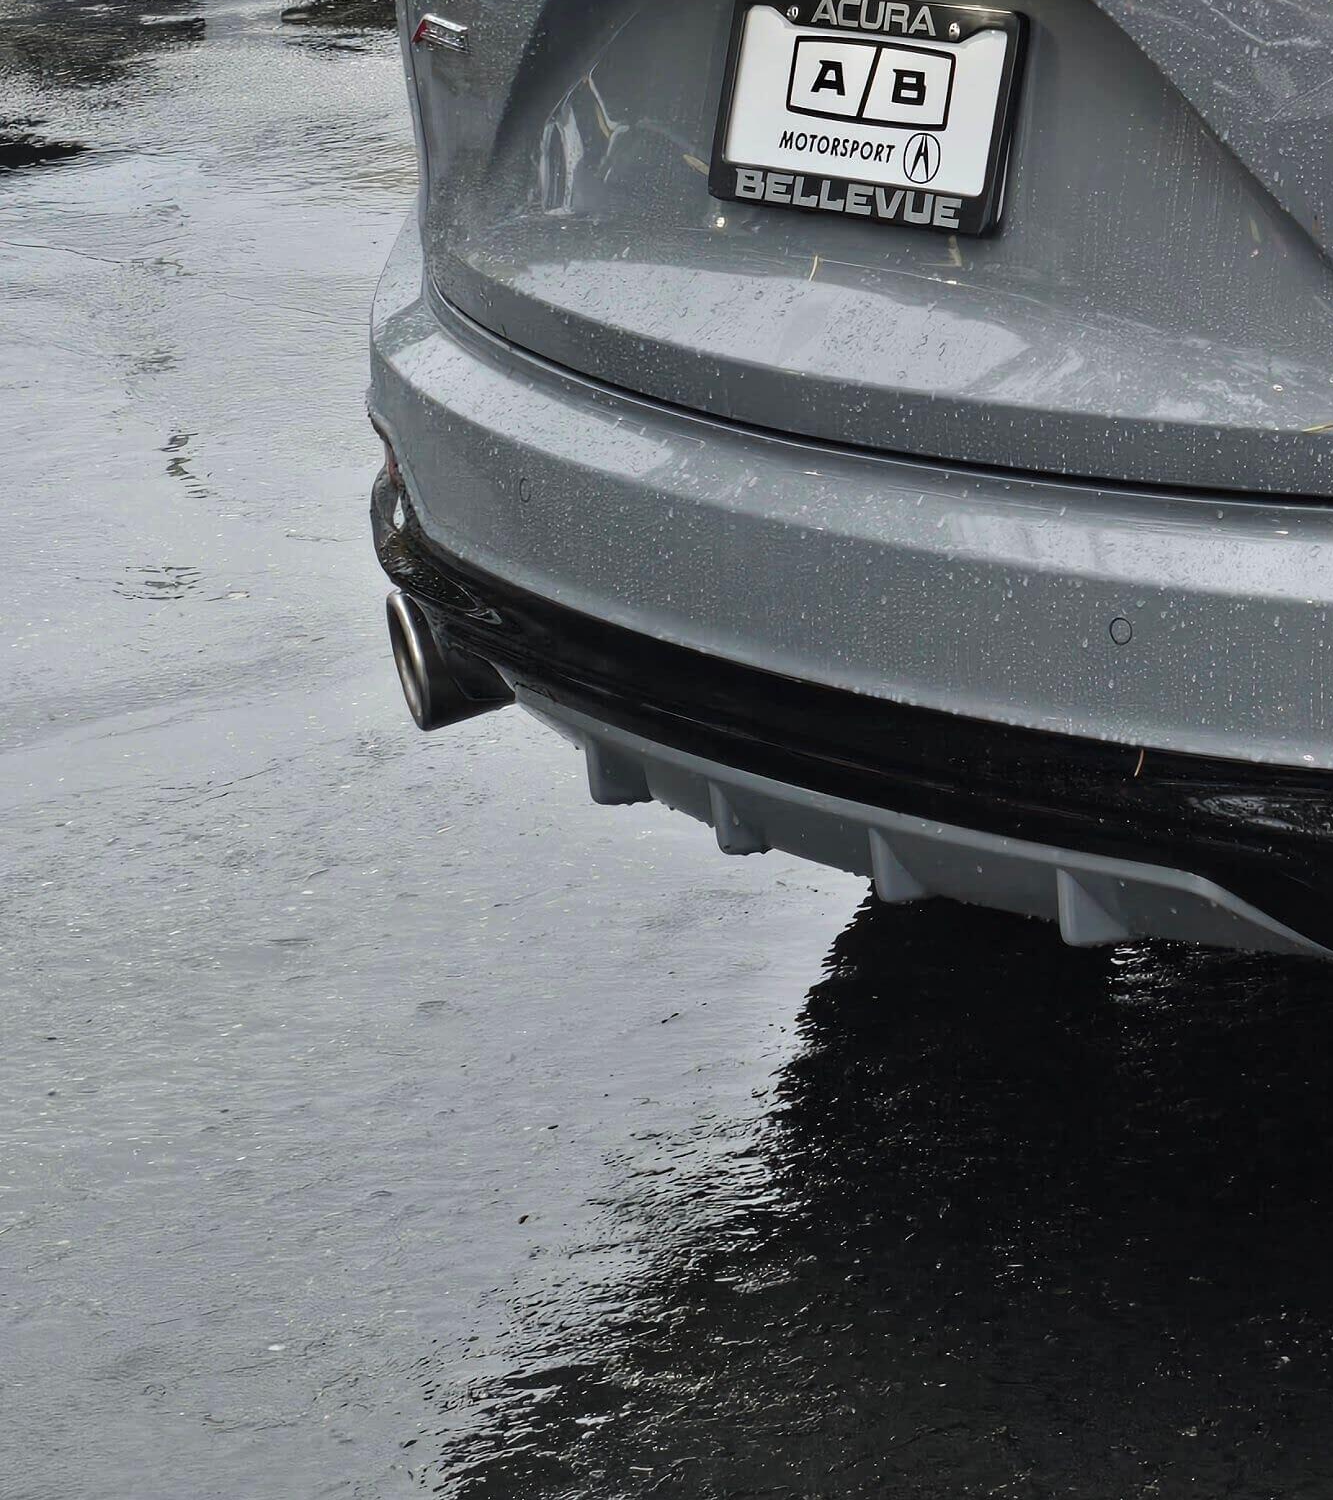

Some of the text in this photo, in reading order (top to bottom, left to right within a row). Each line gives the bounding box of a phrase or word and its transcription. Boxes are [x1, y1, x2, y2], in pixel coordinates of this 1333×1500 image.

[810, 59, 927, 106] A B
[778, 130, 896, 164] MOTORSPORT
[735, 167, 963, 229] BELLEVUE
